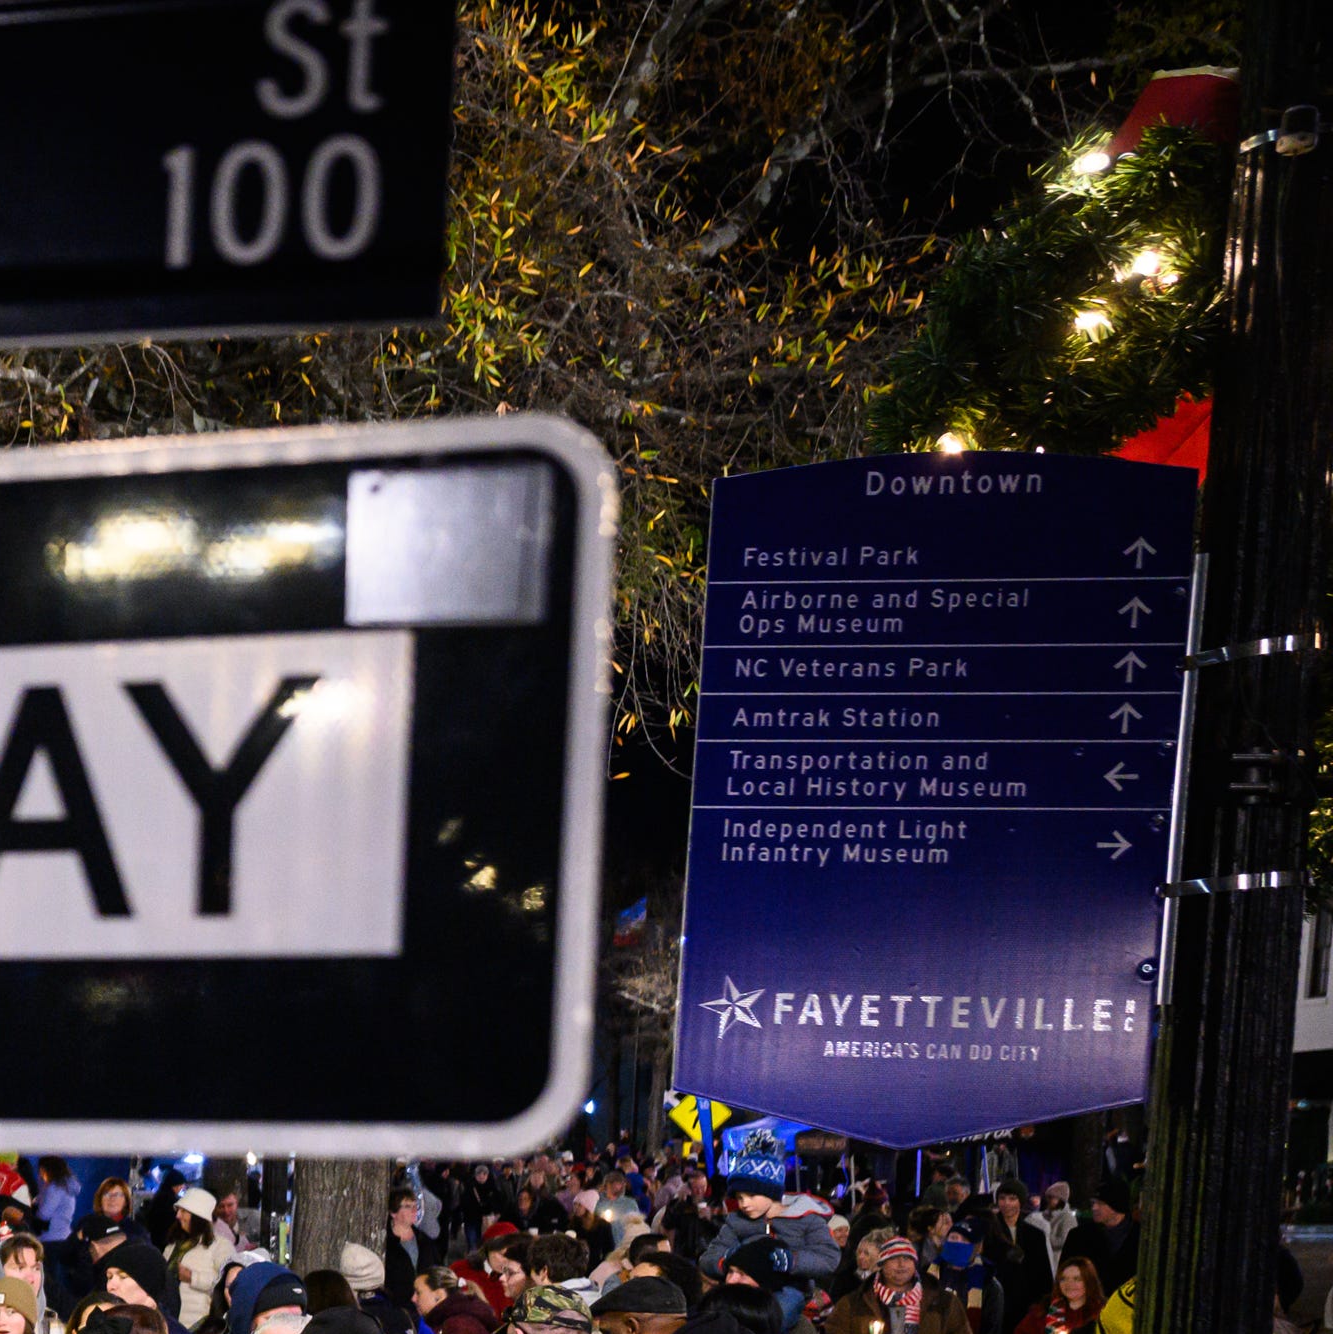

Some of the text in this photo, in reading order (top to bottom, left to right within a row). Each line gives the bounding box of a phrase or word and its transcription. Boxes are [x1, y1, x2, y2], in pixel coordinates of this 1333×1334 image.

[256, 0, 387, 118] St
[162, 134, 380, 269] 100
[866, 470, 1042, 496] Downtown
[743, 545, 918, 567] Festival Park
[741, 588, 1029, 613] Airborne and Special
[739, 614, 903, 639] Ops Museum
[735, 657, 967, 678] NC Veterans Park
[732, 707, 939, 727] Amtrak Station
[729, 750, 988, 775] Transportation and
[726, 776, 1027, 802] Local History Museum
[722, 818, 967, 845] Independent Light
[721, 842, 949, 868] Infantry Museum
[773, 992, 1114, 1032] FAYETTEVILLE
[823, 1040, 1041, 1062] AMERICA'S CAN DO CITY
